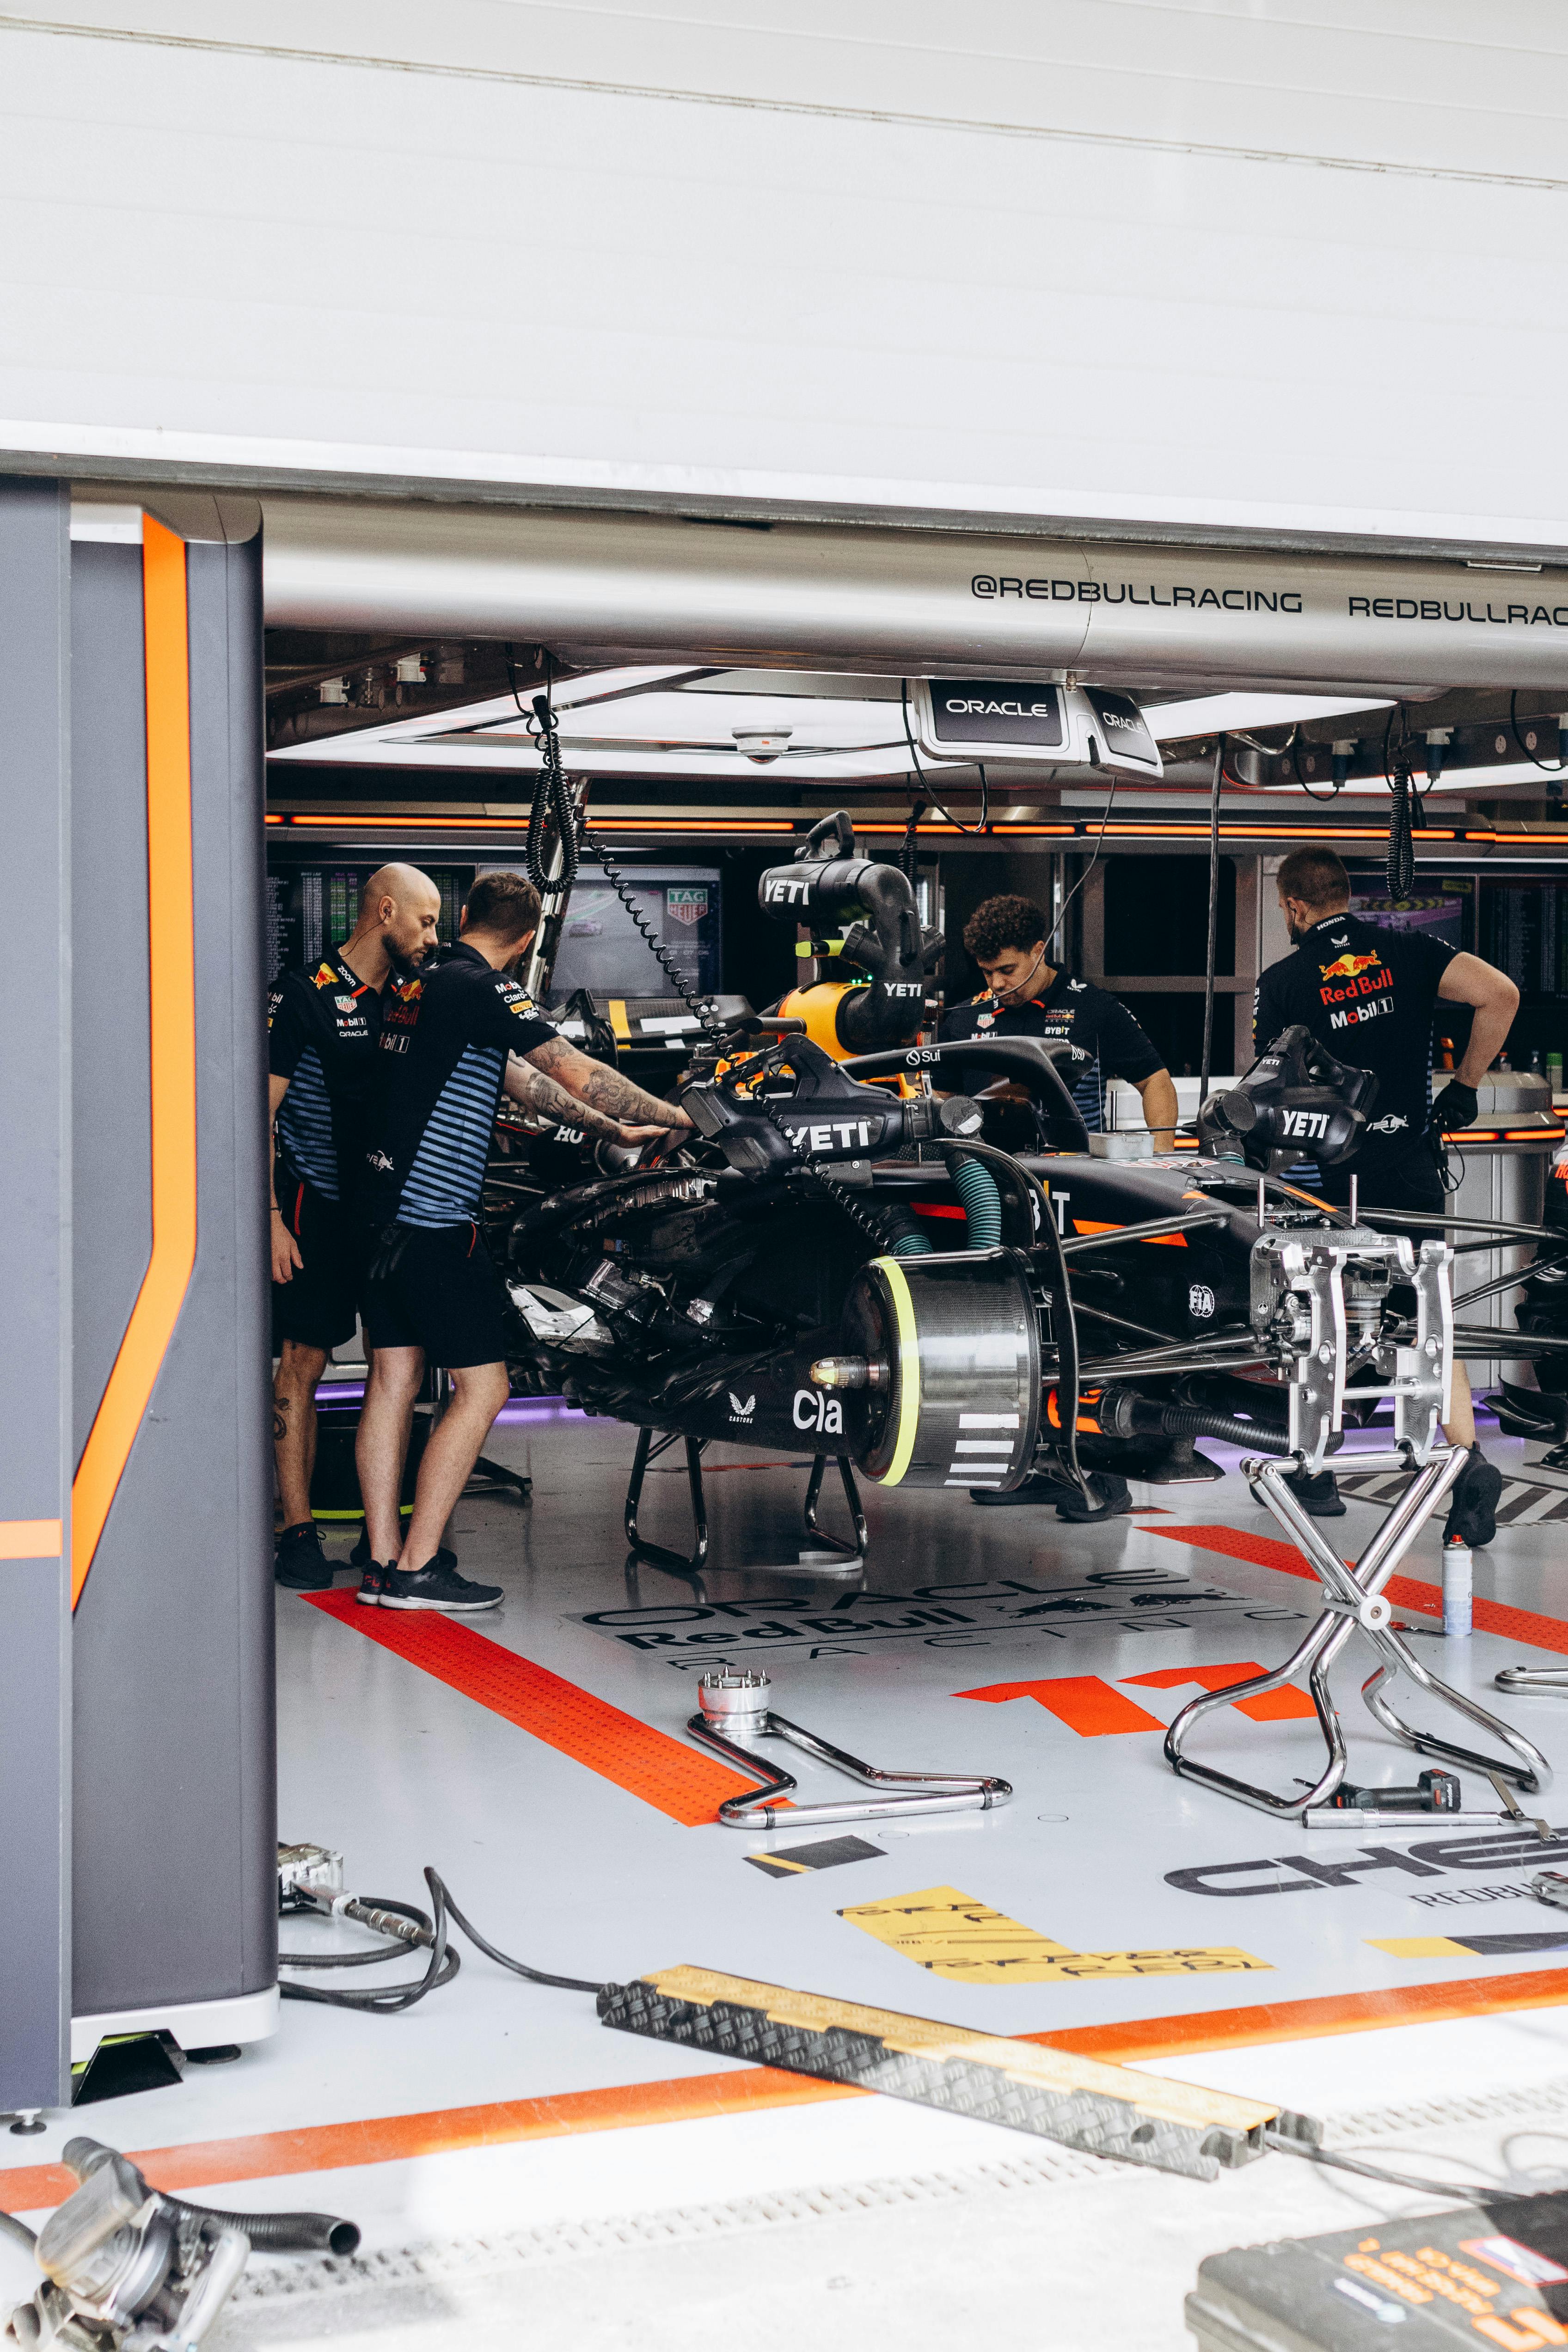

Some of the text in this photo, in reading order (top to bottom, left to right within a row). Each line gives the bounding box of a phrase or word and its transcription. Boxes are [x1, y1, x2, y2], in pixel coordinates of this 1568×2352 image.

[972, 574, 1302, 613] @REDBULLRACING
[946, 699, 1048, 717] ORACLE
[1103, 712, 1145, 735] ORACLE
[670, 891, 704, 902] TAG
[765, 880, 809, 905] YETI
[1316, 916, 1346, 931] HONDA
[337, 965, 356, 987] zoom
[1320, 968, 1393, 1005] Red Bull
[503, 992, 526, 1003] Claro
[884, 983, 921, 997] YETI
[337, 1018, 358, 1027] Mobil
[1330, 1001, 1377, 1029] Mobil
[1045, 1026, 1070, 1035] BYBIT
[922, 1049, 940, 1062] Sui
[1283, 1110, 1327, 1139] YETI
[785, 1121, 869, 1153] YETI
[729, 1415, 753, 1424] CASTORE
[793, 1390, 842, 1434] Cla
[581, 1568, 1190, 1627] ORACLE
[614, 1607, 977, 1650] Red Bull
